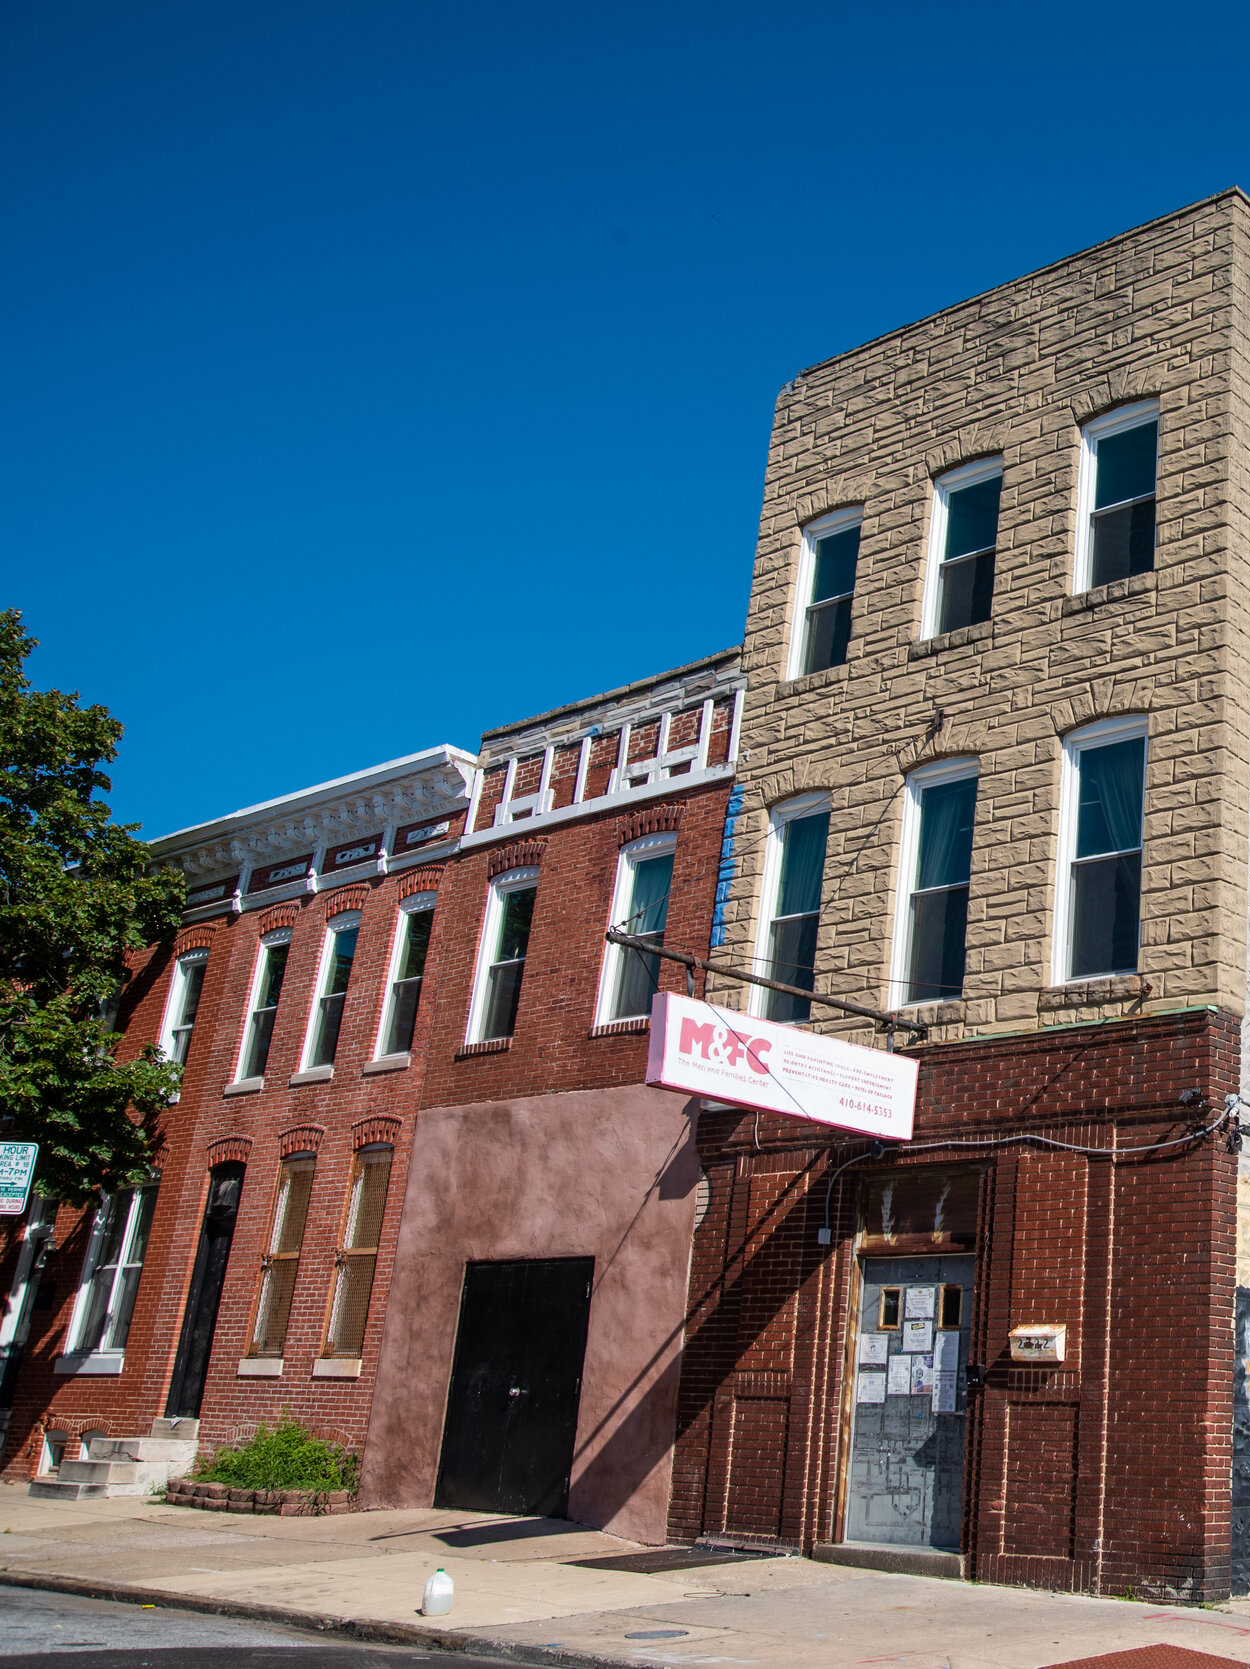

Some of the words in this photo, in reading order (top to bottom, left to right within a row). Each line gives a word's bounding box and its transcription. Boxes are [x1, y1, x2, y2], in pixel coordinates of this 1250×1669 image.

[678, 1016, 773, 1075] M&FC
[807, 1056, 834, 1067] PARENTING
[808, 1065, 836, 1076] ASSISTANCE
[678, 1057, 691, 1067] The
[692, 1061, 706, 1072] Men
[707, 1065, 720, 1075] and
[721, 1069, 747, 1083] Families
[748, 1076, 769, 1088] Center
[782, 1067, 818, 1081] PREVENTATIVE
[819, 1076, 838, 1085] HEALTH
[839, 1096, 893, 1119] 410-614-5353
[3, 1146, 29, 1155] HOUR
